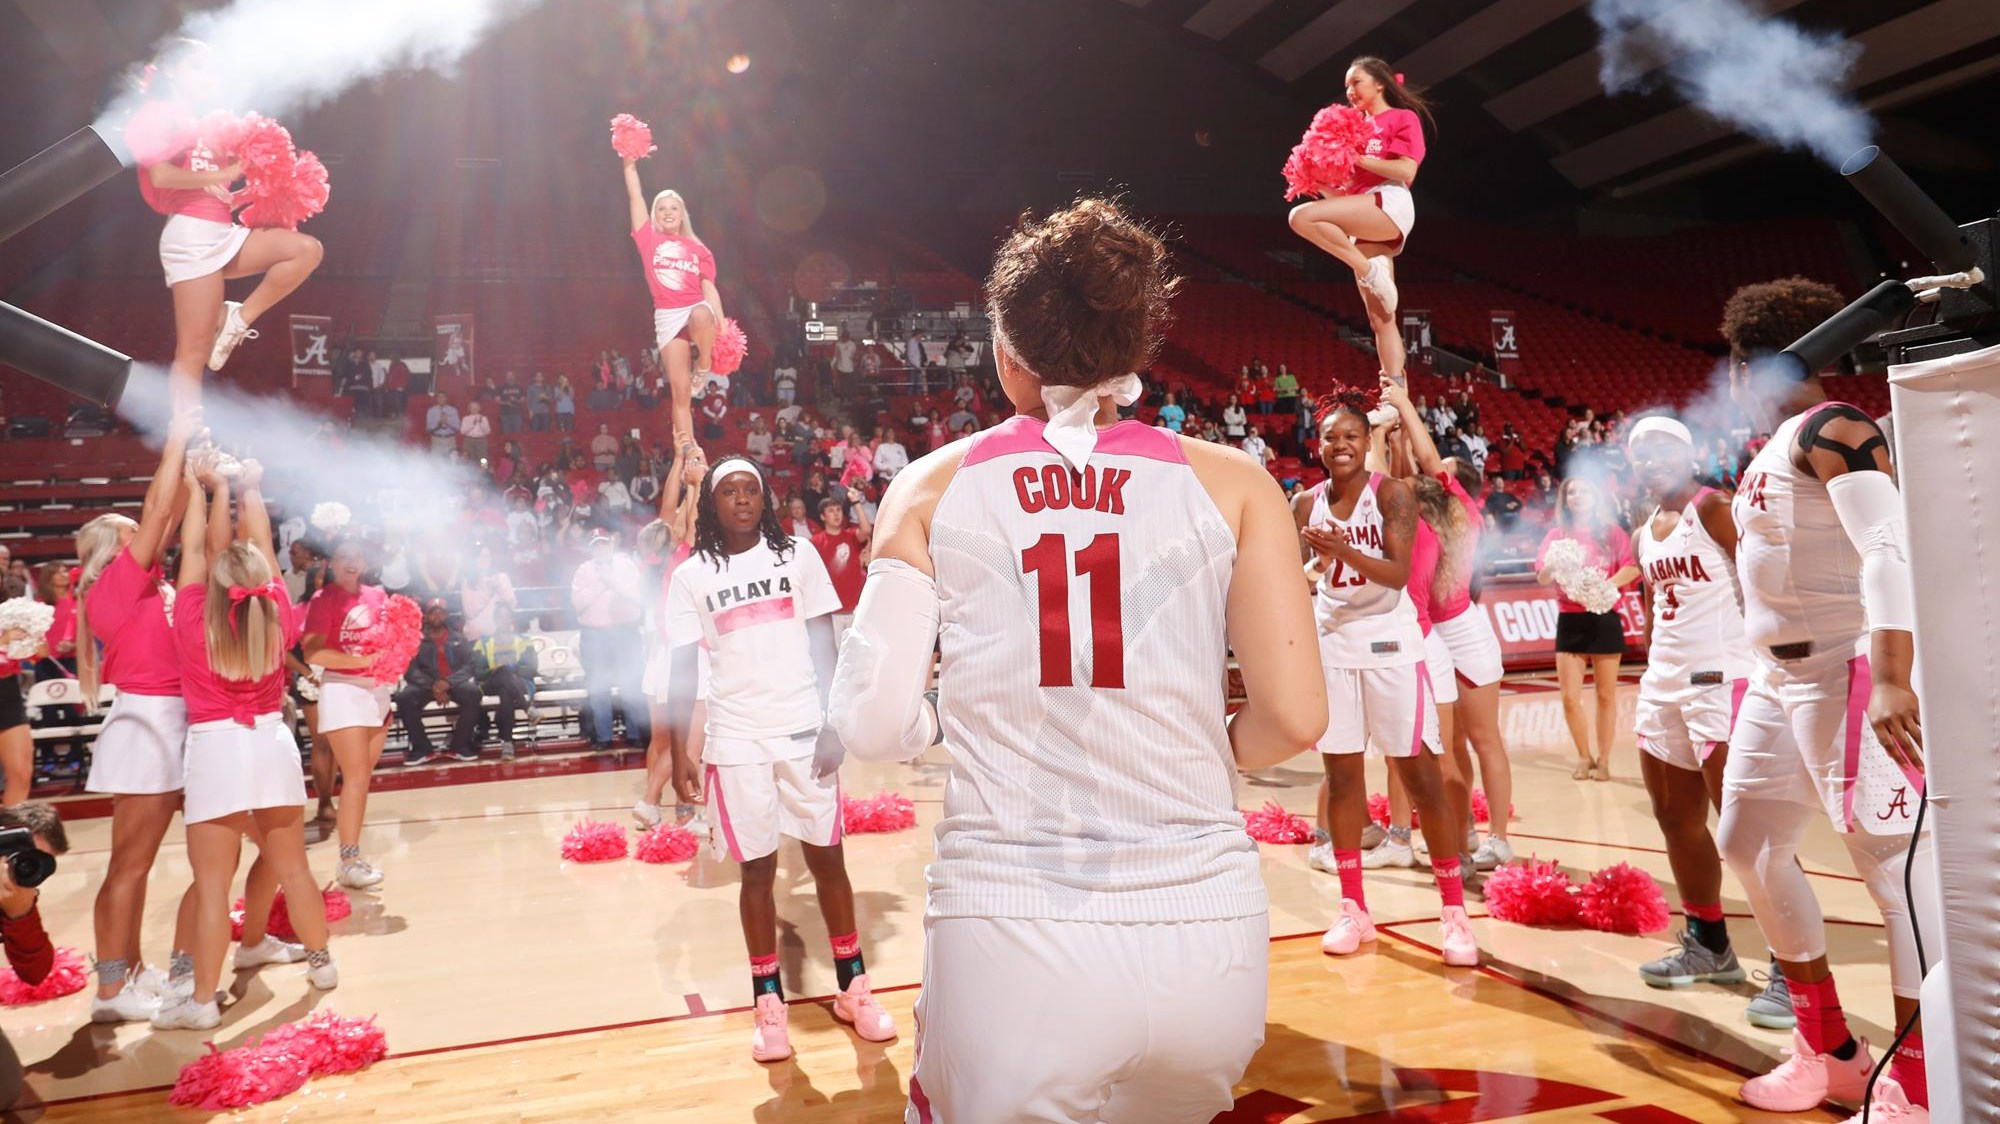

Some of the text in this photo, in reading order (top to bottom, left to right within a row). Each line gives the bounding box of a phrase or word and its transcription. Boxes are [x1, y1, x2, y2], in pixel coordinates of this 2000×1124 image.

[1012, 464, 1131, 515] COOK
[1649, 554, 1713, 583] ABAMA
[706, 577, 792, 612] I PLAY 4
[1021, 533, 1126, 689] 11
